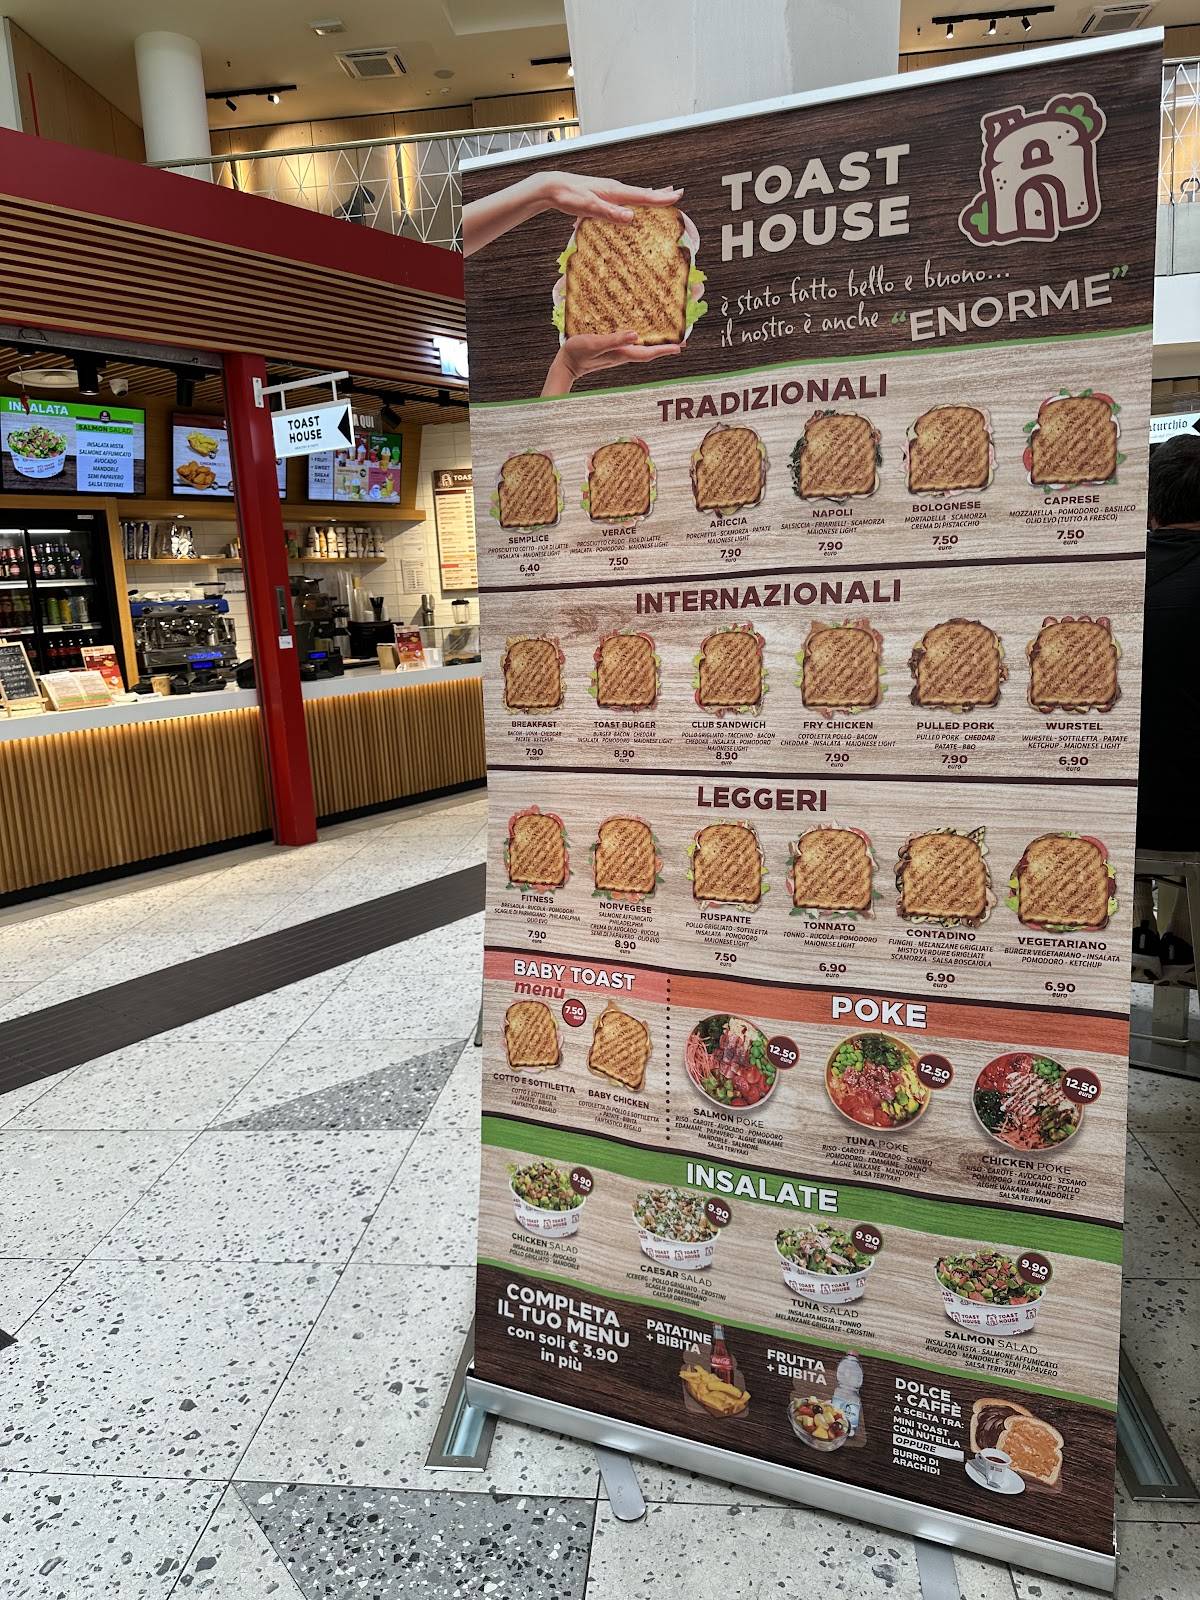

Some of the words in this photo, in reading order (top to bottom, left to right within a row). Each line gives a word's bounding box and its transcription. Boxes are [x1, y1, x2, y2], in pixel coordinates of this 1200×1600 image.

[721, 143, 910, 211] TOAST
[721, 195, 910, 262] HOUSE
[721, 296, 728, 316] è
[738, 285, 780, 315] stato
[790, 276, 837, 303] fatto
[849, 264, 894, 297] bello
[905, 275, 912, 291] e
[721, 318, 733, 347] il
[742, 316, 793, 342] nostro
[804, 313, 811, 334] è
[822, 301, 878, 331] anche
[657, 373, 887, 422] TRADIZIONALI
[288, 416, 319, 430] TOAST
[360, 415, 374, 428] QUI
[1150, 419, 1187, 431] turchio
[290, 429, 322, 443] HOUSE
[912, 501, 981, 513] BOLOGNESE
[1044, 494, 1100, 506] CAPRESE
[812, 509, 853, 518] NAPOLI
[905, 514, 946, 523] MORTADELLA
[951, 512, 987, 520] SCAMORZA
[1009, 509, 1053, 518] MOZZARELLA
[1058, 507, 1099, 516] POMODORO
[1105, 504, 1136, 513] BASILICO
[710, 516, 747, 528] ARICCIA
[508, 534, 549, 544] SEMPLICE
[602, 527, 637, 537] VERACE
[1057, 529, 1085, 541] 7.50
[818, 541, 843, 551] 7.90
[932, 534, 958, 546] 7.50
[720, 548, 742, 558] 7.90
[519, 563, 540, 572] 6.40
[609, 557, 628, 566] 7.50
[636, 579, 901, 614] INTERNAZIONALI
[691, 721, 715, 729] CLUB
[716, 721, 766, 729] SANDWICH
[826, 721, 874, 729] CHICKEN
[917, 722, 959, 730] PULLED
[962, 722, 995, 730] PORK
[1046, 722, 1104, 731] WURSTEL
[526, 748, 543, 756] 7.90
[1100, 742, 1121, 750] LIGHT
[614, 750, 634, 758] 8.90
[715, 752, 738, 761] 8.90
[825, 753, 850, 763] 7.90
[941, 755, 968, 764] 7.90
[1059, 756, 1089, 766] 6.90
[698, 786, 827, 811] LEGGERI
[521, 894, 554, 904] FITNESS
[599, 902, 652, 913] NORVEGESE
[700, 912, 752, 924] RUSPANTE
[804, 921, 856, 932] TONNATO
[527, 930, 547, 940] 7.90
[906, 929, 976, 941] CONTADINO
[615, 940, 636, 950] 8.90
[1017, 937, 1107, 951] VEGETARIANO
[714, 952, 737, 963] 7.50
[1022, 956, 1064, 966] POMODORO
[1069, 959, 1103, 968] KETCHUP
[513, 958, 566, 981] BABY
[570, 966, 635, 991] TOAST
[819, 963, 847, 973] 6.90
[926, 972, 956, 983] 6.90
[514, 981, 566, 999] menù
[1045, 982, 1076, 993] 6.90
[565, 1005, 584, 1016] 7.50
[831, 995, 928, 1029] POKE
[769, 1044, 796, 1059] 12.50
[920, 1063, 950, 1078] 12.50
[493, 1073, 520, 1083] COTTO
[529, 1080, 576, 1093] SOTTILETTA
[1066, 1078, 1097, 1094] 12.50
[588, 1089, 611, 1100] BABY
[613, 1094, 649, 1109] CHICKEN
[694, 1108, 734, 1122] SALMON
[736, 1116, 764, 1128] POKE
[846, 1136, 876, 1148] TUNA
[878, 1140, 908, 1152] POKE
[982, 1155, 1034, 1169] CHICKEN
[1036, 1162, 1071, 1174] POKE
[572, 1173, 592, 1187] 9.90
[687, 1163, 838, 1213] INSALATE
[708, 1203, 729, 1219] 9.90
[512, 1232, 547, 1248] CHICKEN
[549, 1241, 578, 1254] SALAD
[855, 1231, 880, 1245] 9.90
[1022, 1259, 1049, 1274] 9.90
[640, 1264, 679, 1279] CAESAR
[681, 1272, 712, 1287] SALAD
[506, 1283, 620, 1328] COMPLETA
[792, 1299, 820, 1311] TUNA
[822, 1305, 859, 1318] SALAD
[498, 1299, 514, 1318] IL
[519, 1304, 562, 1329] TUO
[566, 1316, 630, 1348] MENU
[646, 1318, 712, 1346] PATATINE
[507, 1325, 535, 1342] con
[539, 1333, 565, 1350] soli
[568, 1340, 578, 1353] €
[583, 1345, 619, 1363] 3.90
[656, 1334, 701, 1354] BIBITA
[926, 1338, 956, 1349] INSALATA
[957, 1344, 977, 1353] MISTA
[982, 1348, 1013, 1360] SALMONE
[944, 1330, 995, 1346] SALMON
[997, 1339, 1038, 1354] SALAD
[540, 1347, 555, 1363] in
[558, 1355, 583, 1372] più
[767, 1348, 826, 1373] FRUTTA
[778, 1364, 827, 1386] BIBITA
[895, 1377, 951, 1401] DOLCE
[907, 1394, 962, 1418] CAFFÈ
[893, 1405, 902, 1413] A
[903, 1407, 939, 1423] SCELTA
[941, 1416, 964, 1428] TRA:
[893, 1416, 915, 1428] MINI
[917, 1421, 949, 1436] TOAST
[893, 1425, 914, 1438] CON
[915, 1430, 961, 1448] NUTELLA
[895, 1437, 936, 1453] OPPURE
[893, 1448, 927, 1463] BURRO
[929, 1456, 939, 1466] DI
[892, 1457, 941, 1476] ARACHIDI
